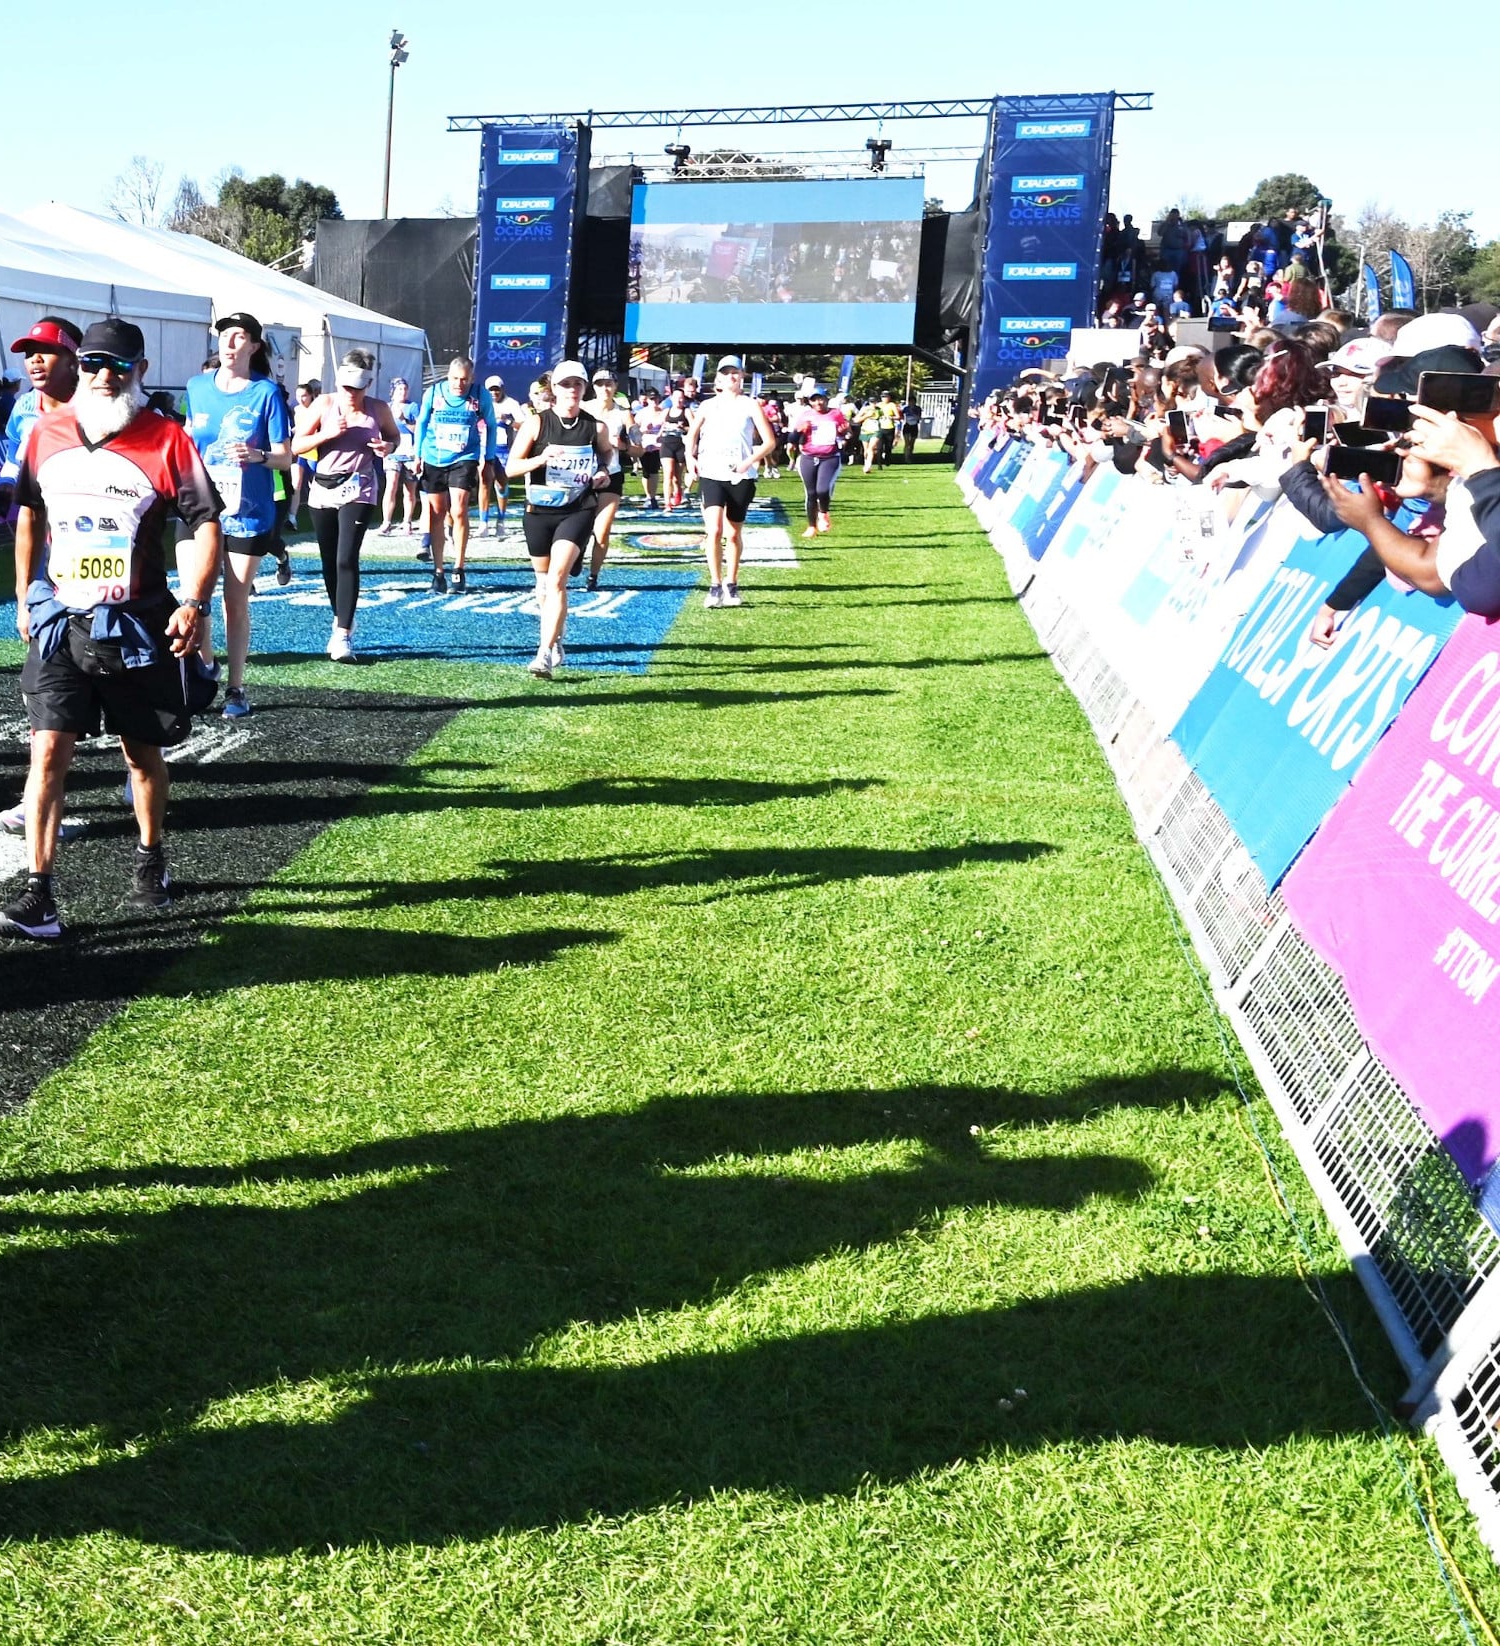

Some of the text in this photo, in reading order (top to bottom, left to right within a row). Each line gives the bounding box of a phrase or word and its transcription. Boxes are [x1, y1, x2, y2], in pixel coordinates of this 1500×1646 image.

[1020, 123, 1085, 135] TOTALSPORTS
[503, 152, 555, 162] TOTALSPORTS
[1018, 178, 1078, 188] TOTALSPORTS
[1009, 207, 1080, 219] OCEANS
[495, 225, 553, 236] OCEANS
[1008, 267, 1072, 276] TOTALSPORTS
[1006, 320, 1065, 329] TOTALSPORTS
[1388, 758, 1465, 849] THE
